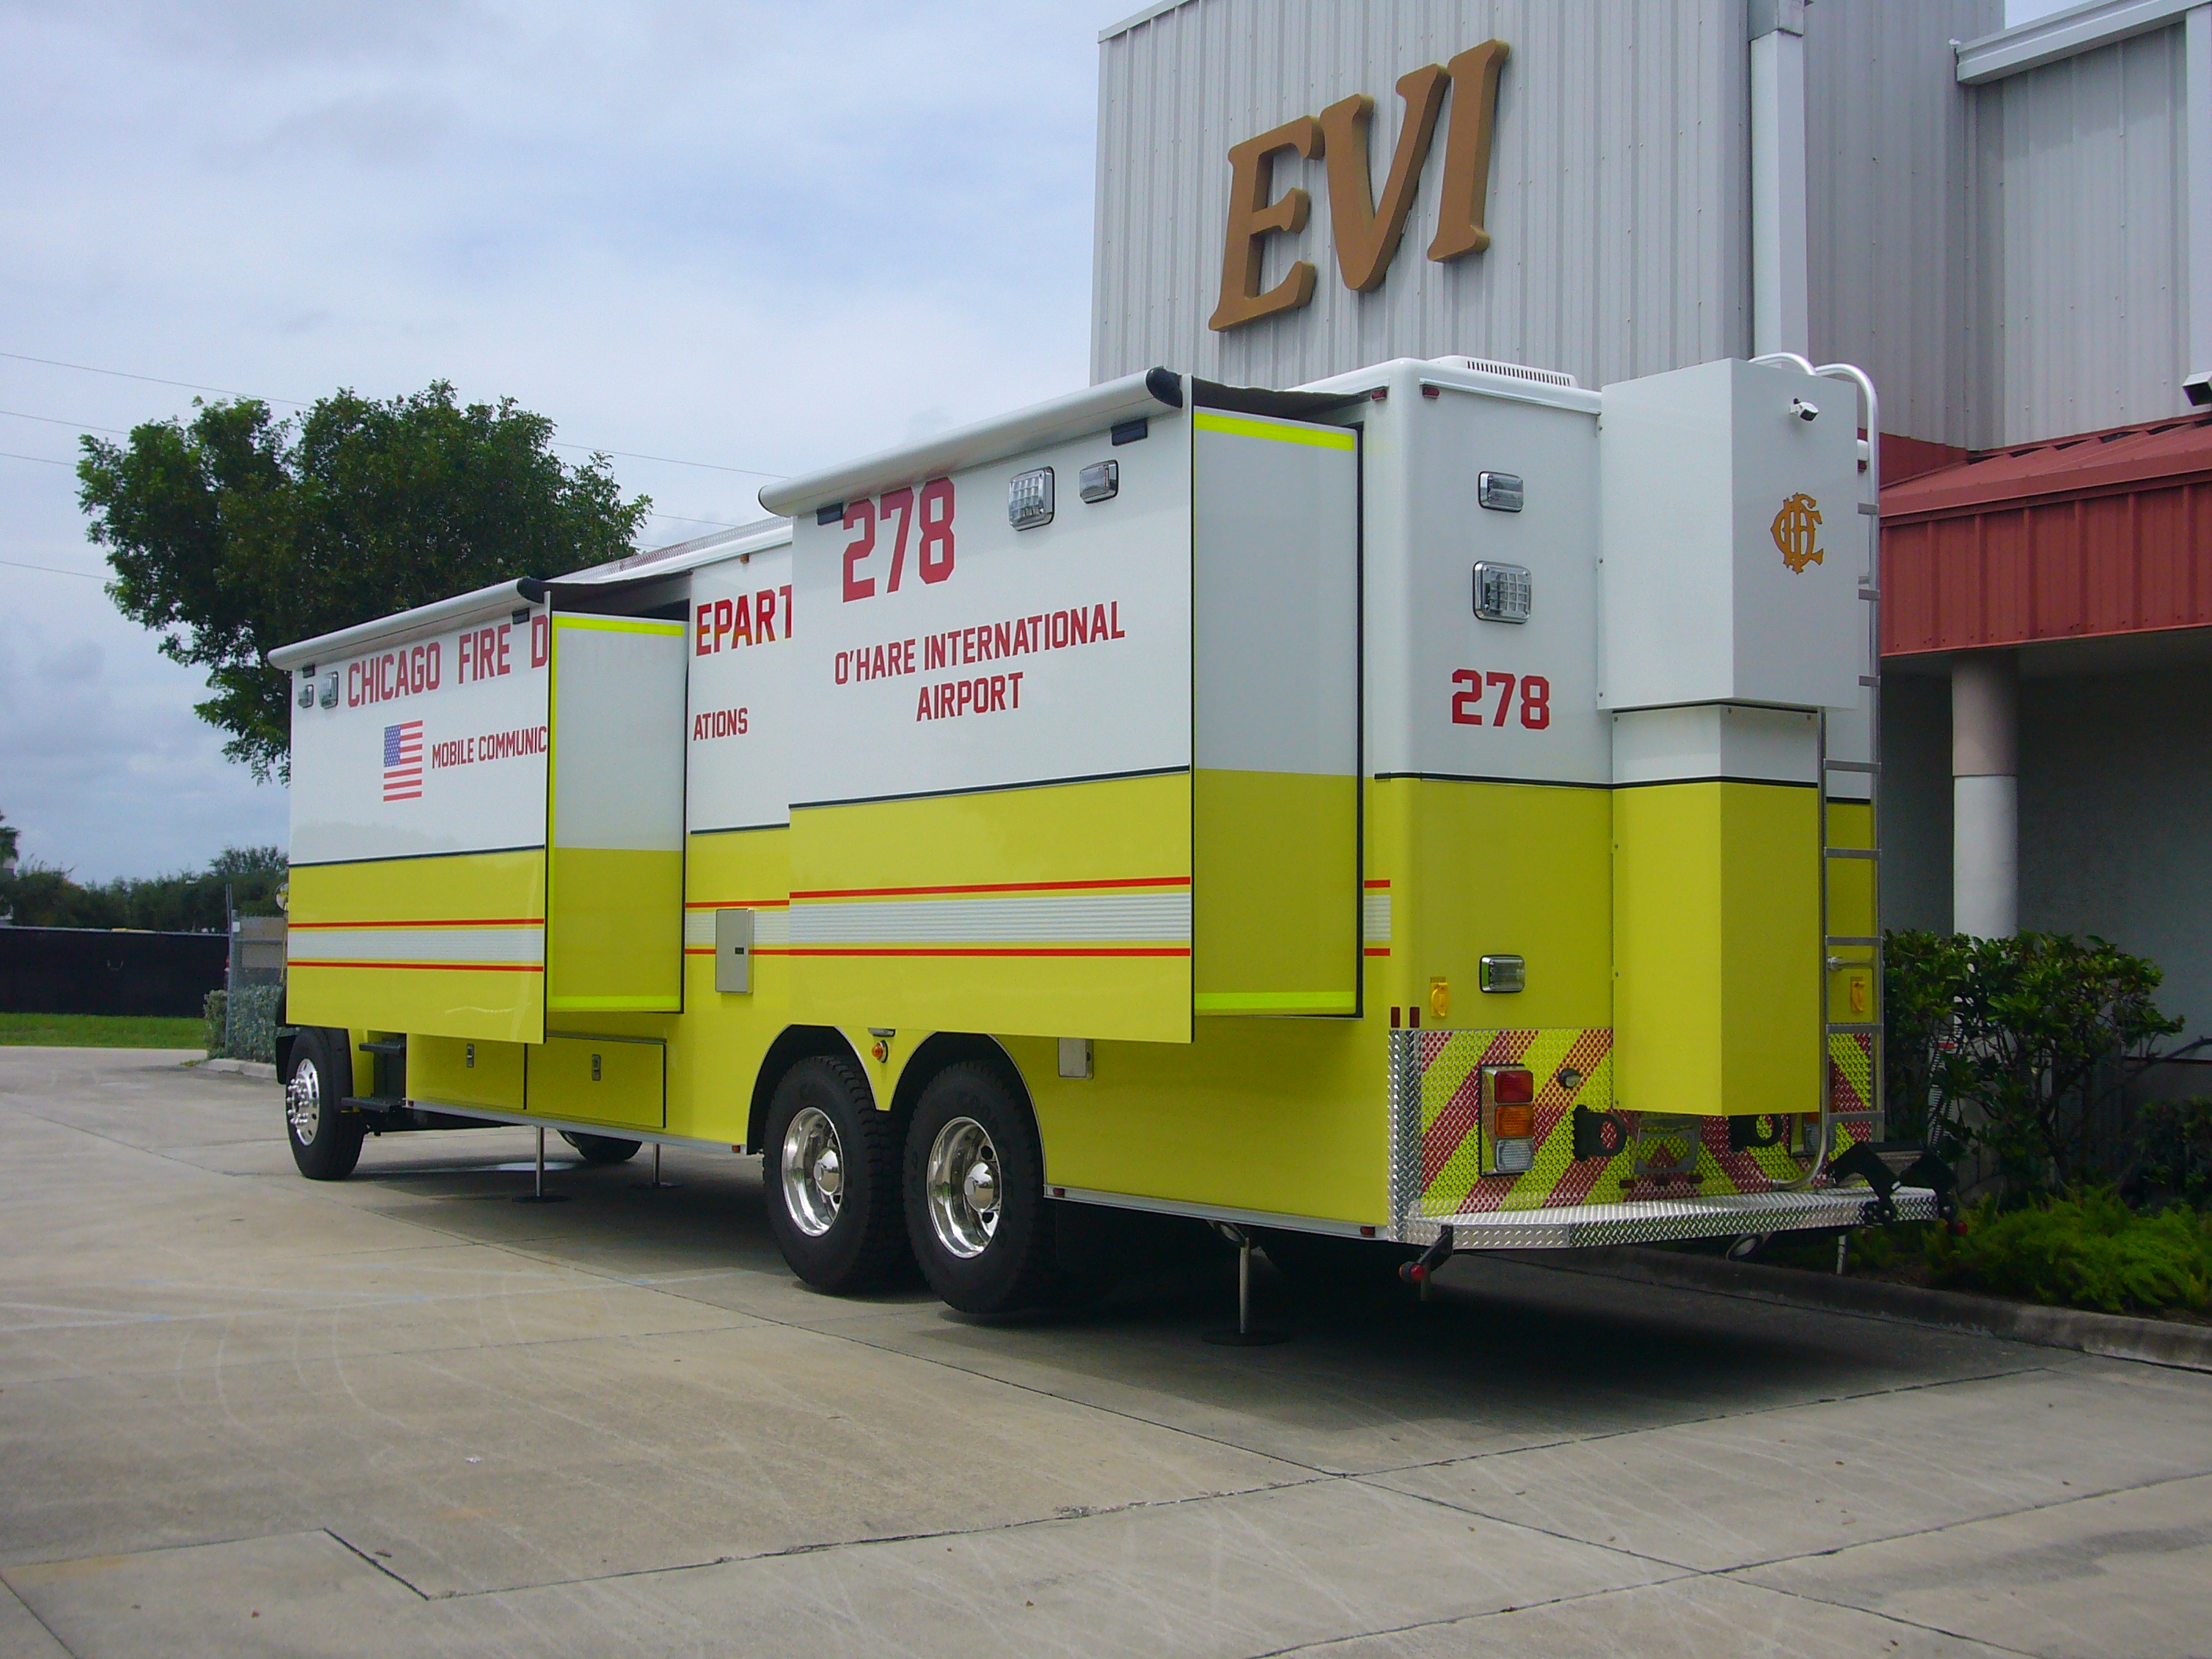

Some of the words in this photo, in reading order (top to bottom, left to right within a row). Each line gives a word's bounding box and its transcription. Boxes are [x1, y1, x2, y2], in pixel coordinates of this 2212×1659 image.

[1208, 38, 1511, 332] EVI
[842, 476, 955, 603] 278
[348, 641, 441, 707] CHICAGO
[458, 623, 511, 684] FIRE
[532, 614, 548, 668] D
[834, 638, 916, 686] O'HARE
[924, 600, 1126, 671] INTERNATIONAL
[693, 707, 749, 741] ATIONS
[916, 672, 1024, 723] AIRPORT
[1451, 668, 1551, 730] 278
[432, 737, 474, 769] MOBILE
[478, 726, 548, 762] COMMUNIC
